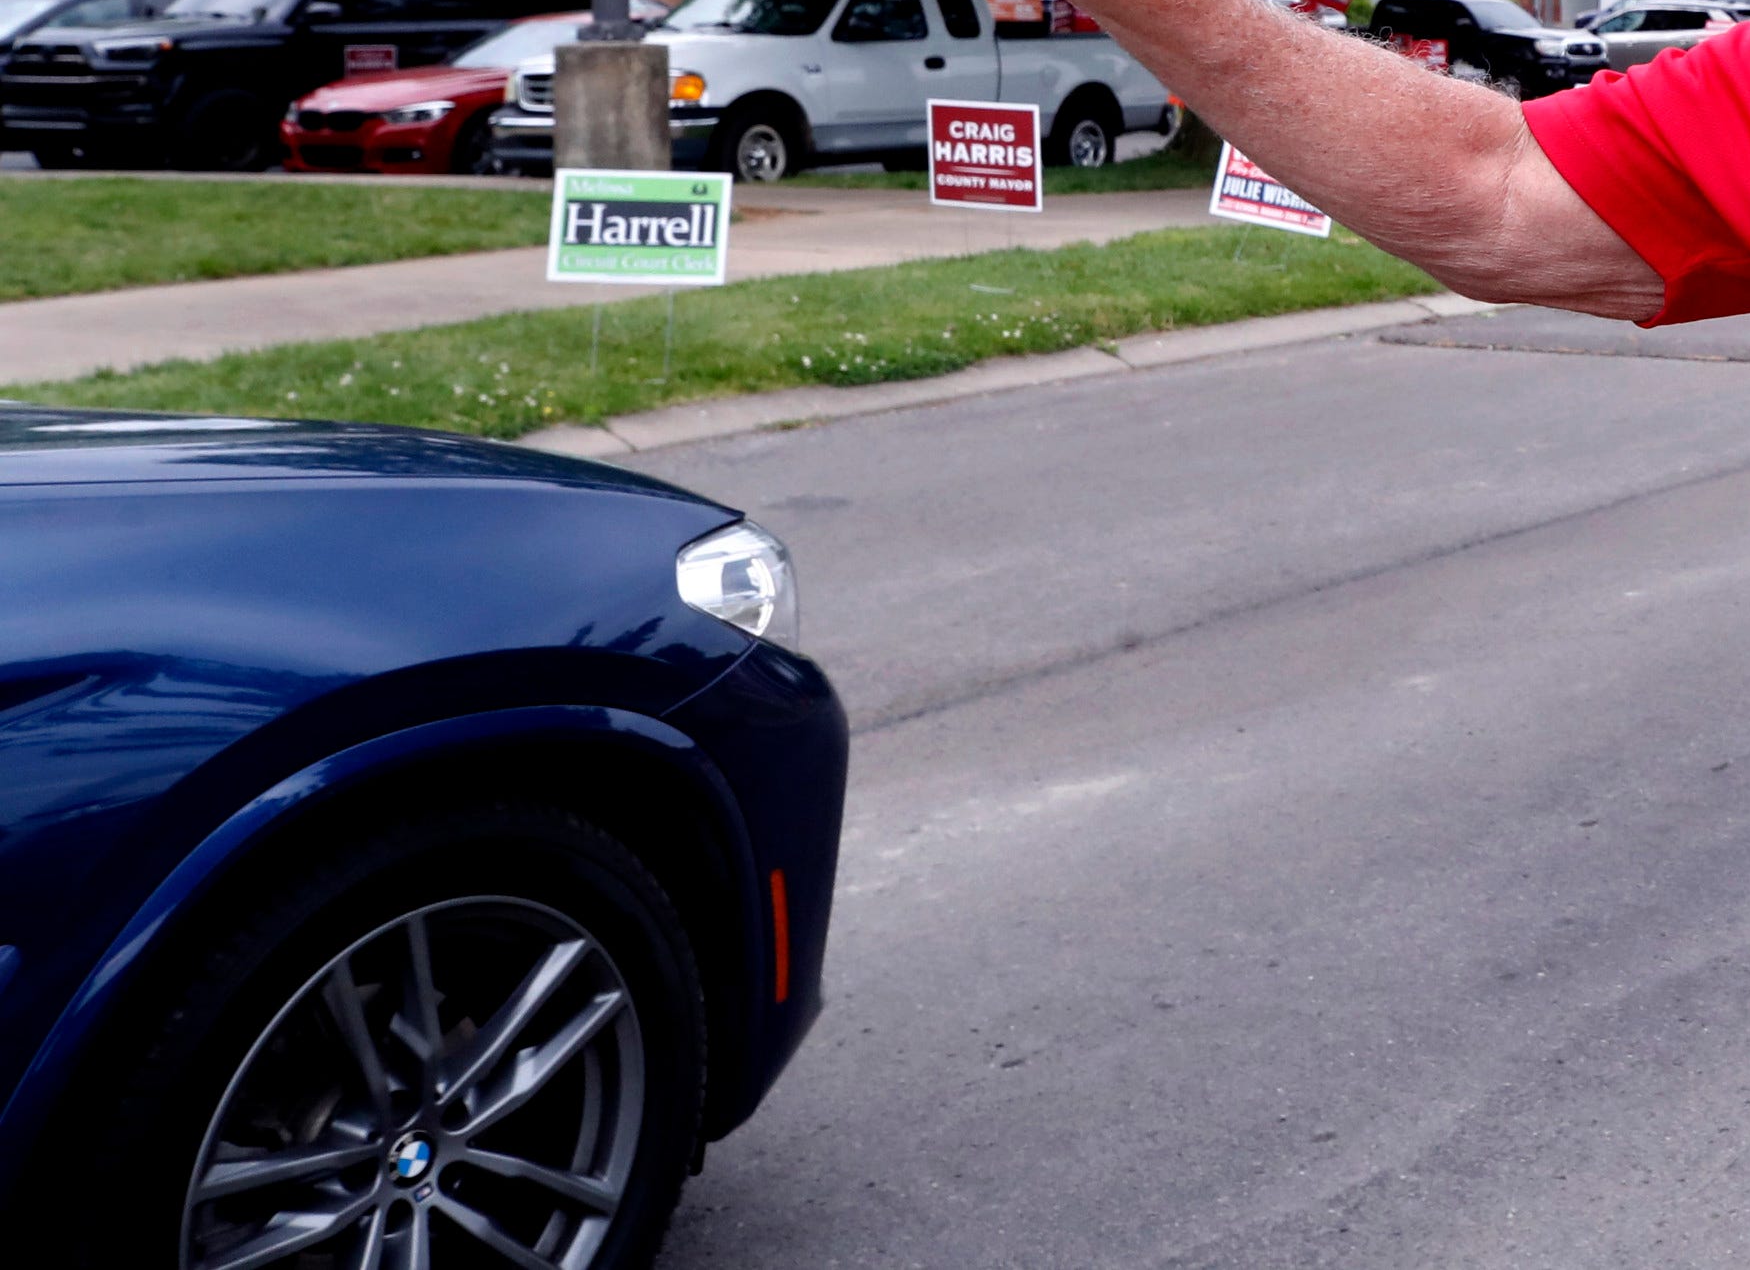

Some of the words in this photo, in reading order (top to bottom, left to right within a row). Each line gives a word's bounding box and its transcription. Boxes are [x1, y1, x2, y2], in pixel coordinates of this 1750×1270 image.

[949, 120, 1016, 143] CRAIG
[934, 140, 1034, 168] HARRIS
[936, 173, 987, 189] COUNTY
[988, 177, 1034, 192] MAYOR
[1222, 175, 1263, 200] JULIE
[563, 202, 716, 247] Harrell
[620, 252, 669, 271] Court
